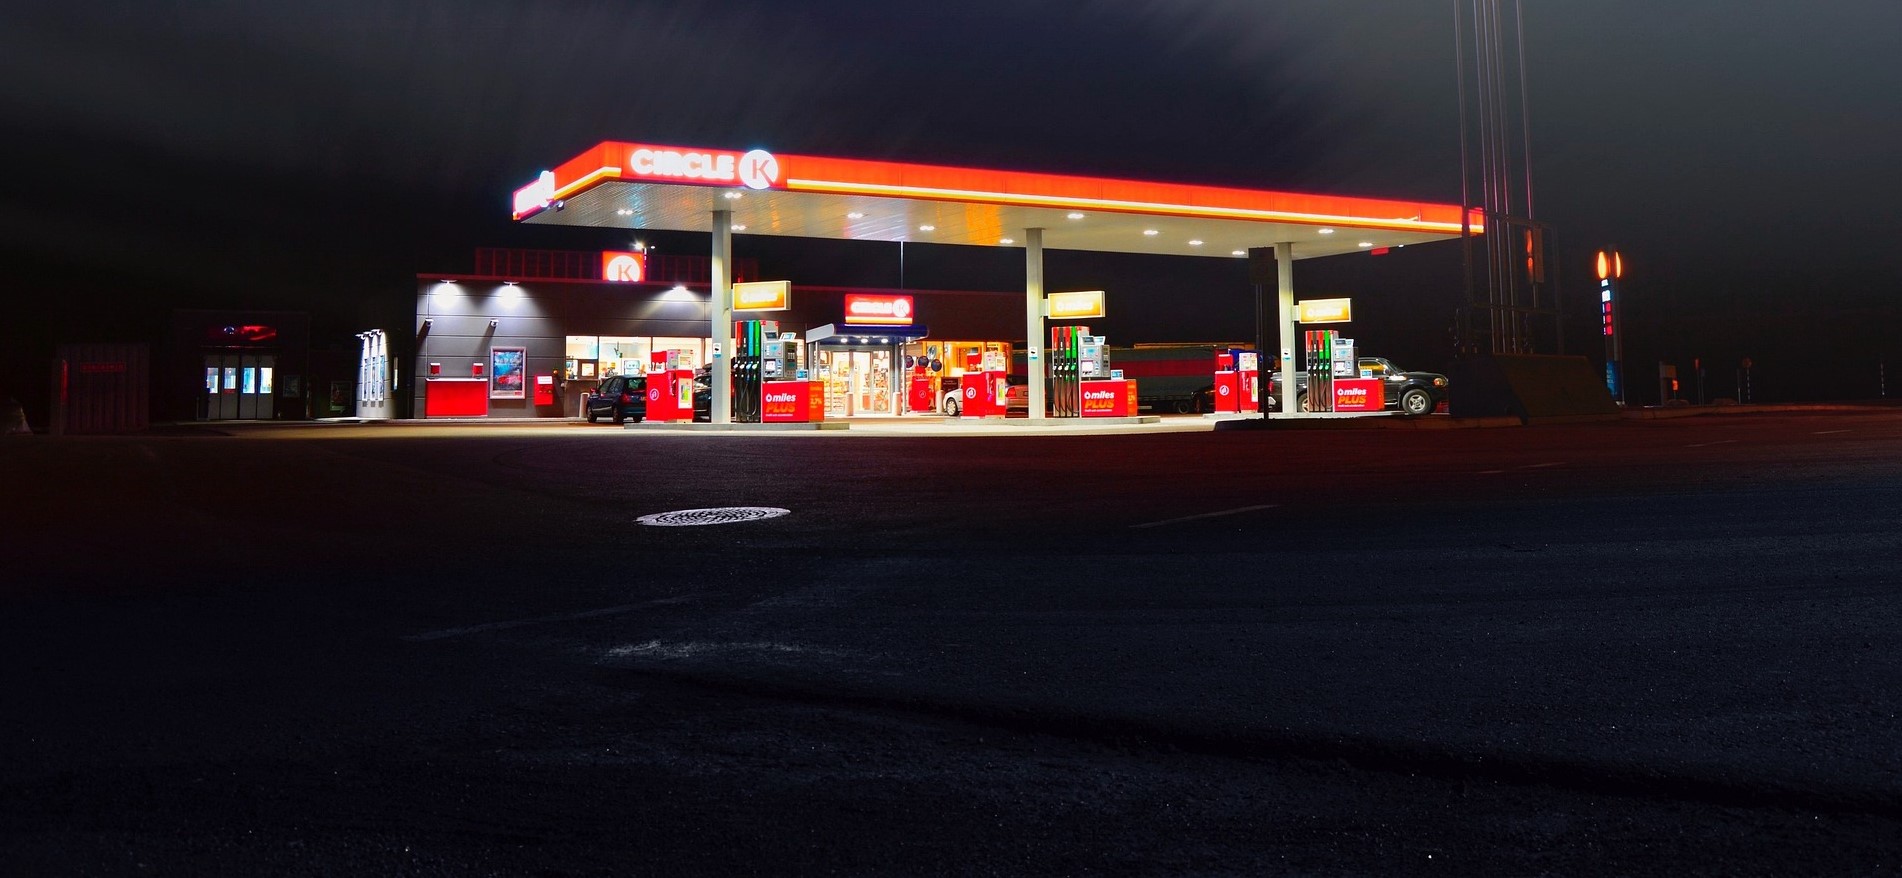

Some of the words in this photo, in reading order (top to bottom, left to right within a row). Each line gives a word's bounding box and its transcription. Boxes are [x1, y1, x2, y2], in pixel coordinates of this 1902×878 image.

[630, 149, 734, 179] CIRCLE
[1091, 390, 1115, 399] miles
[1344, 388, 1367, 396] miles
[772, 392, 796, 402] miles
[1338, 396, 1366, 404] PLUS
[765, 403, 795, 413] PLUS
[1084, 400, 1114, 409] PLUS
